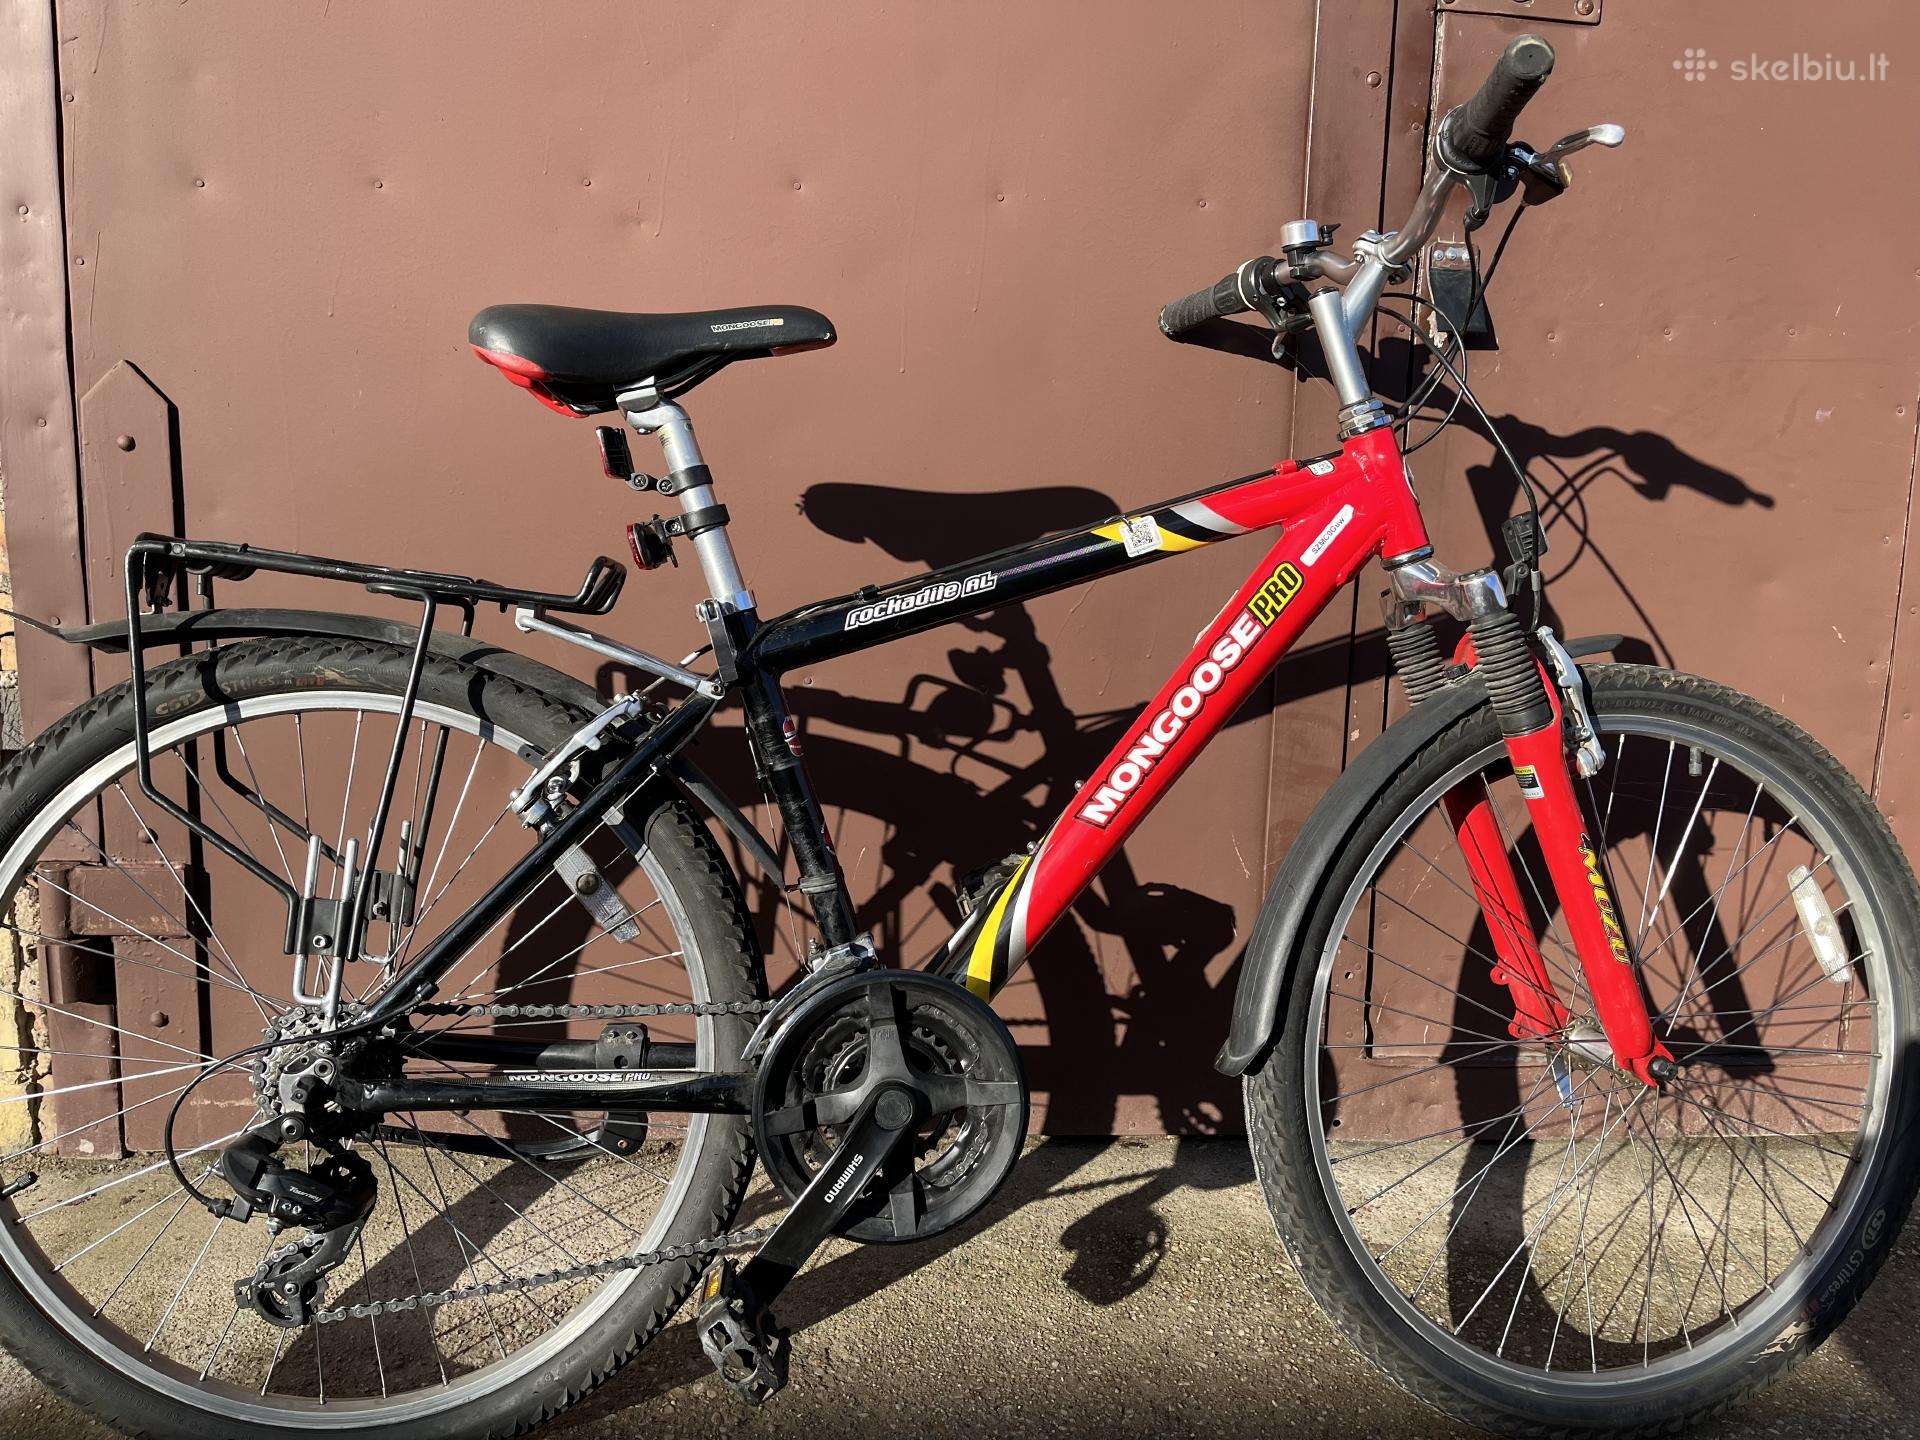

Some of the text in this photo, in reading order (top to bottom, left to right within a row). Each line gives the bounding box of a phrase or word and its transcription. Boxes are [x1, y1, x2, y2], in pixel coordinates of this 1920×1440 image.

[711, 319, 770, 333] MONGOOSE
[845, 572, 997, 629] rockadile AL
[1081, 562, 1304, 825] MONGOOSE PRO
[508, 1072, 652, 1083] MONGOOSE PRO
[823, 1153, 864, 1203] SHIMANO
